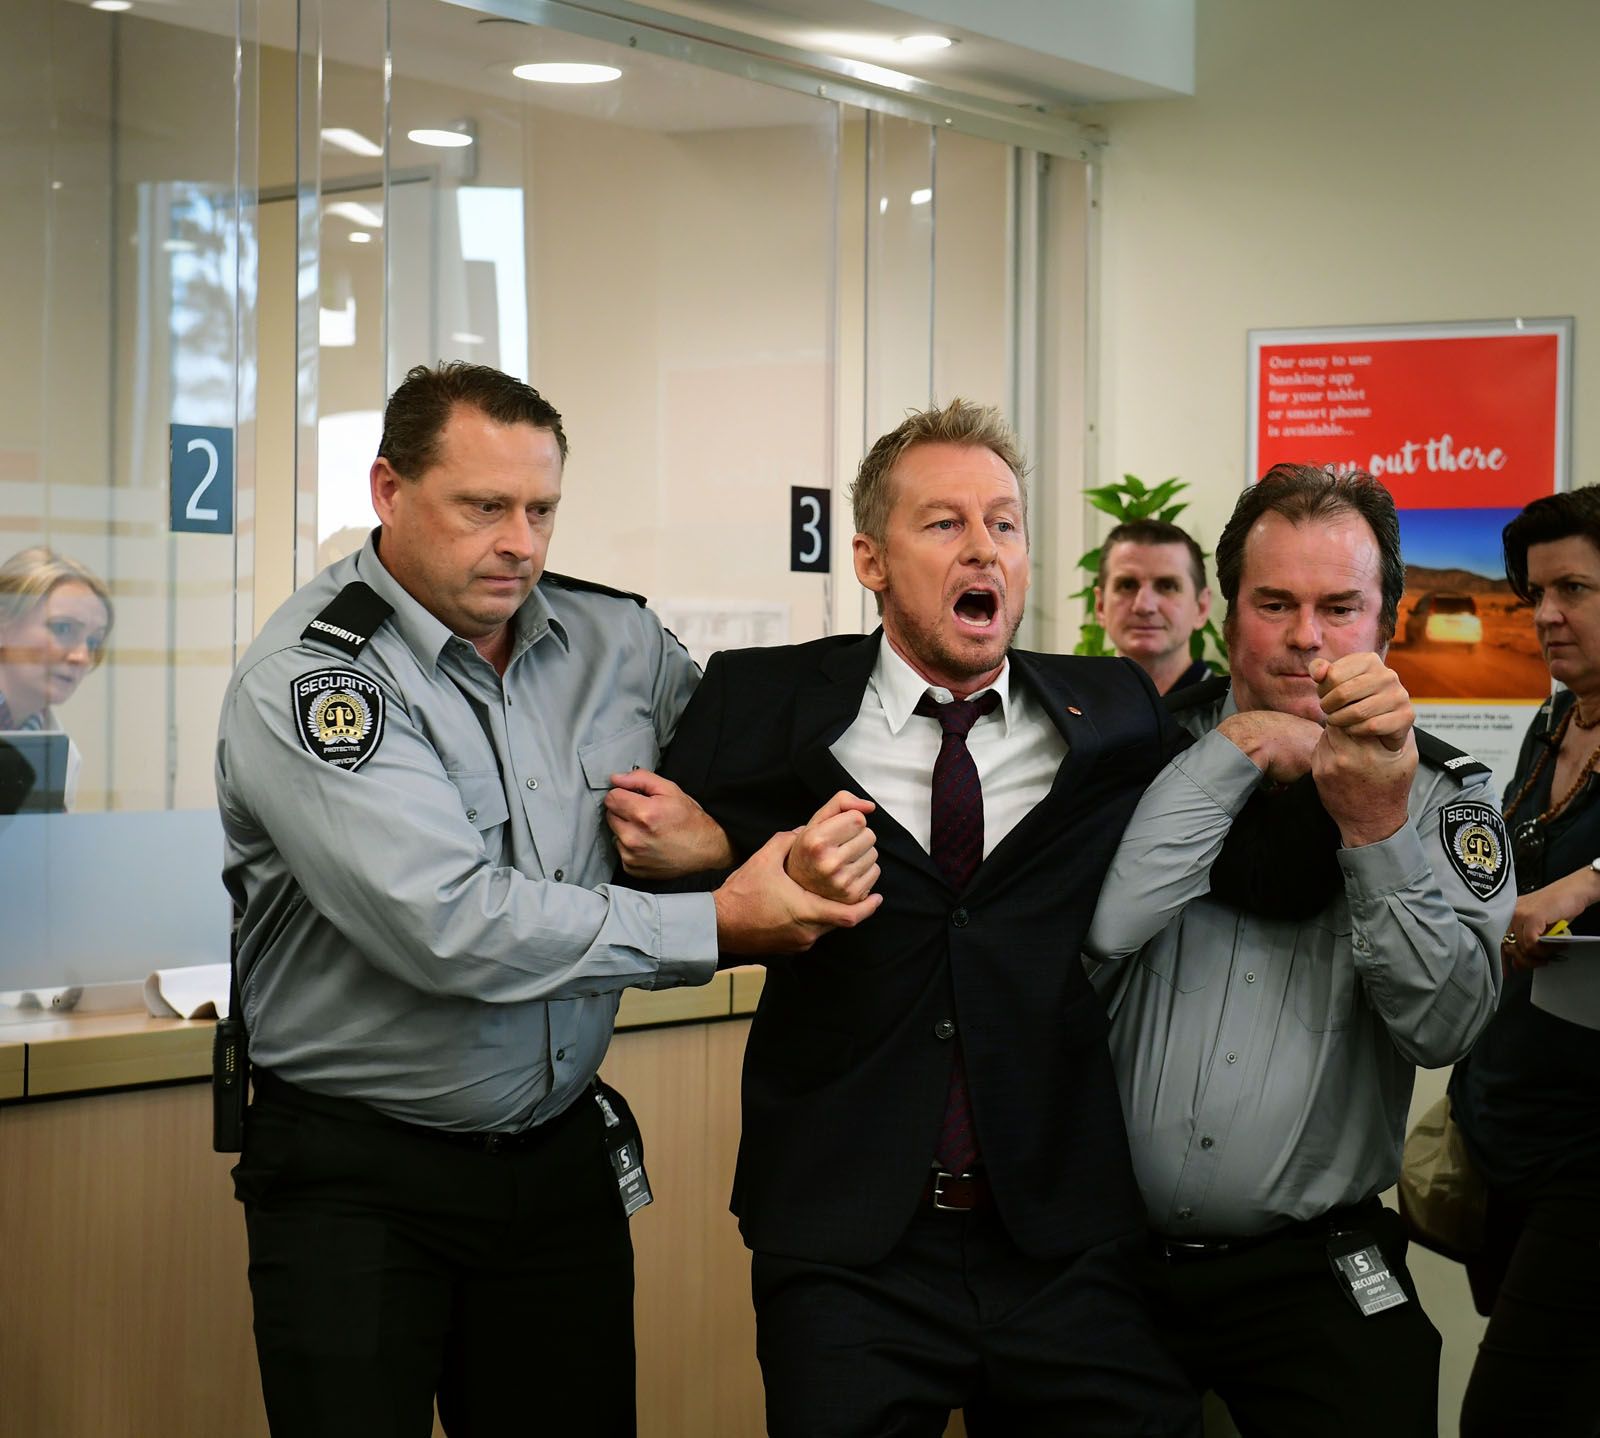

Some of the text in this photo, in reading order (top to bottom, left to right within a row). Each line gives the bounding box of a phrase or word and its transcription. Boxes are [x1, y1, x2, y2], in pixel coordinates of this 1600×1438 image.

[1269, 354, 1373, 370] Our easy to use
[1269, 372, 1354, 387] banking app
[1269, 388, 1366, 405] for your tablet
[1268, 404, 1372, 421] or smart phone
[1268, 424, 1279, 437] is
[1369, 440, 1421, 477] out
[1424, 433, 1508, 473] there
[186, 437, 219, 521] 2
[799, 494, 822, 565] 3
[310, 619, 366, 646] SECURITY
[300, 675, 376, 697] SECURITY
[323, 745, 361, 754] PROTECTIVE
[1447, 808, 1502, 833] SECURITY
[620, 1148, 631, 1169] S
[1354, 1254, 1370, 1273] S
[1350, 1269, 1391, 1292] SECURITY
